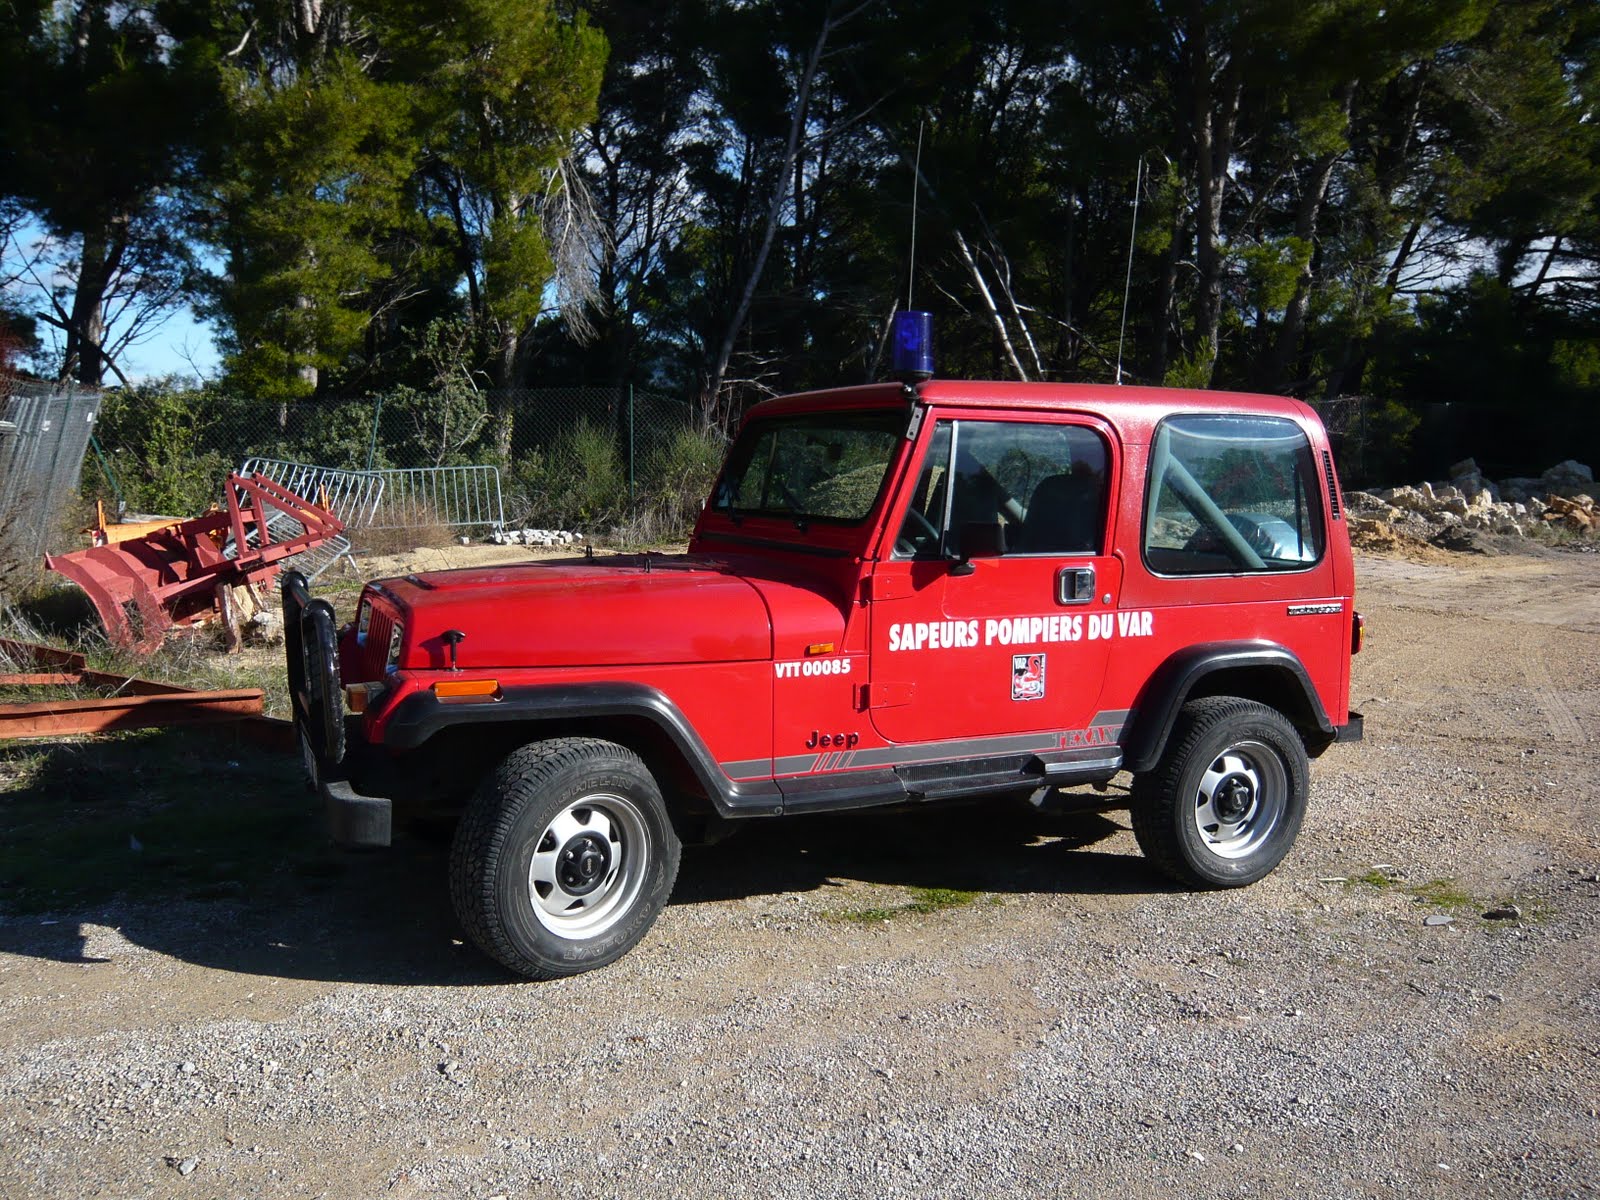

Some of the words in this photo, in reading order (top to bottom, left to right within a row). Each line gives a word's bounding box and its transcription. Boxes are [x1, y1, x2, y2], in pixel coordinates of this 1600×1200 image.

[888, 620, 979, 652] SAPEURS
[984, 615, 1083, 646] POMPIERS
[1087, 613, 1114, 640] DU
[1117, 611, 1153, 638] VAR
[774, 661, 801, 679] VTT
[802, 658, 851, 677] 00085
[805, 729, 859, 751] Jeep
[1052, 726, 1122, 749] TEXAN
[534, 775, 633, 829] MICHELIN
